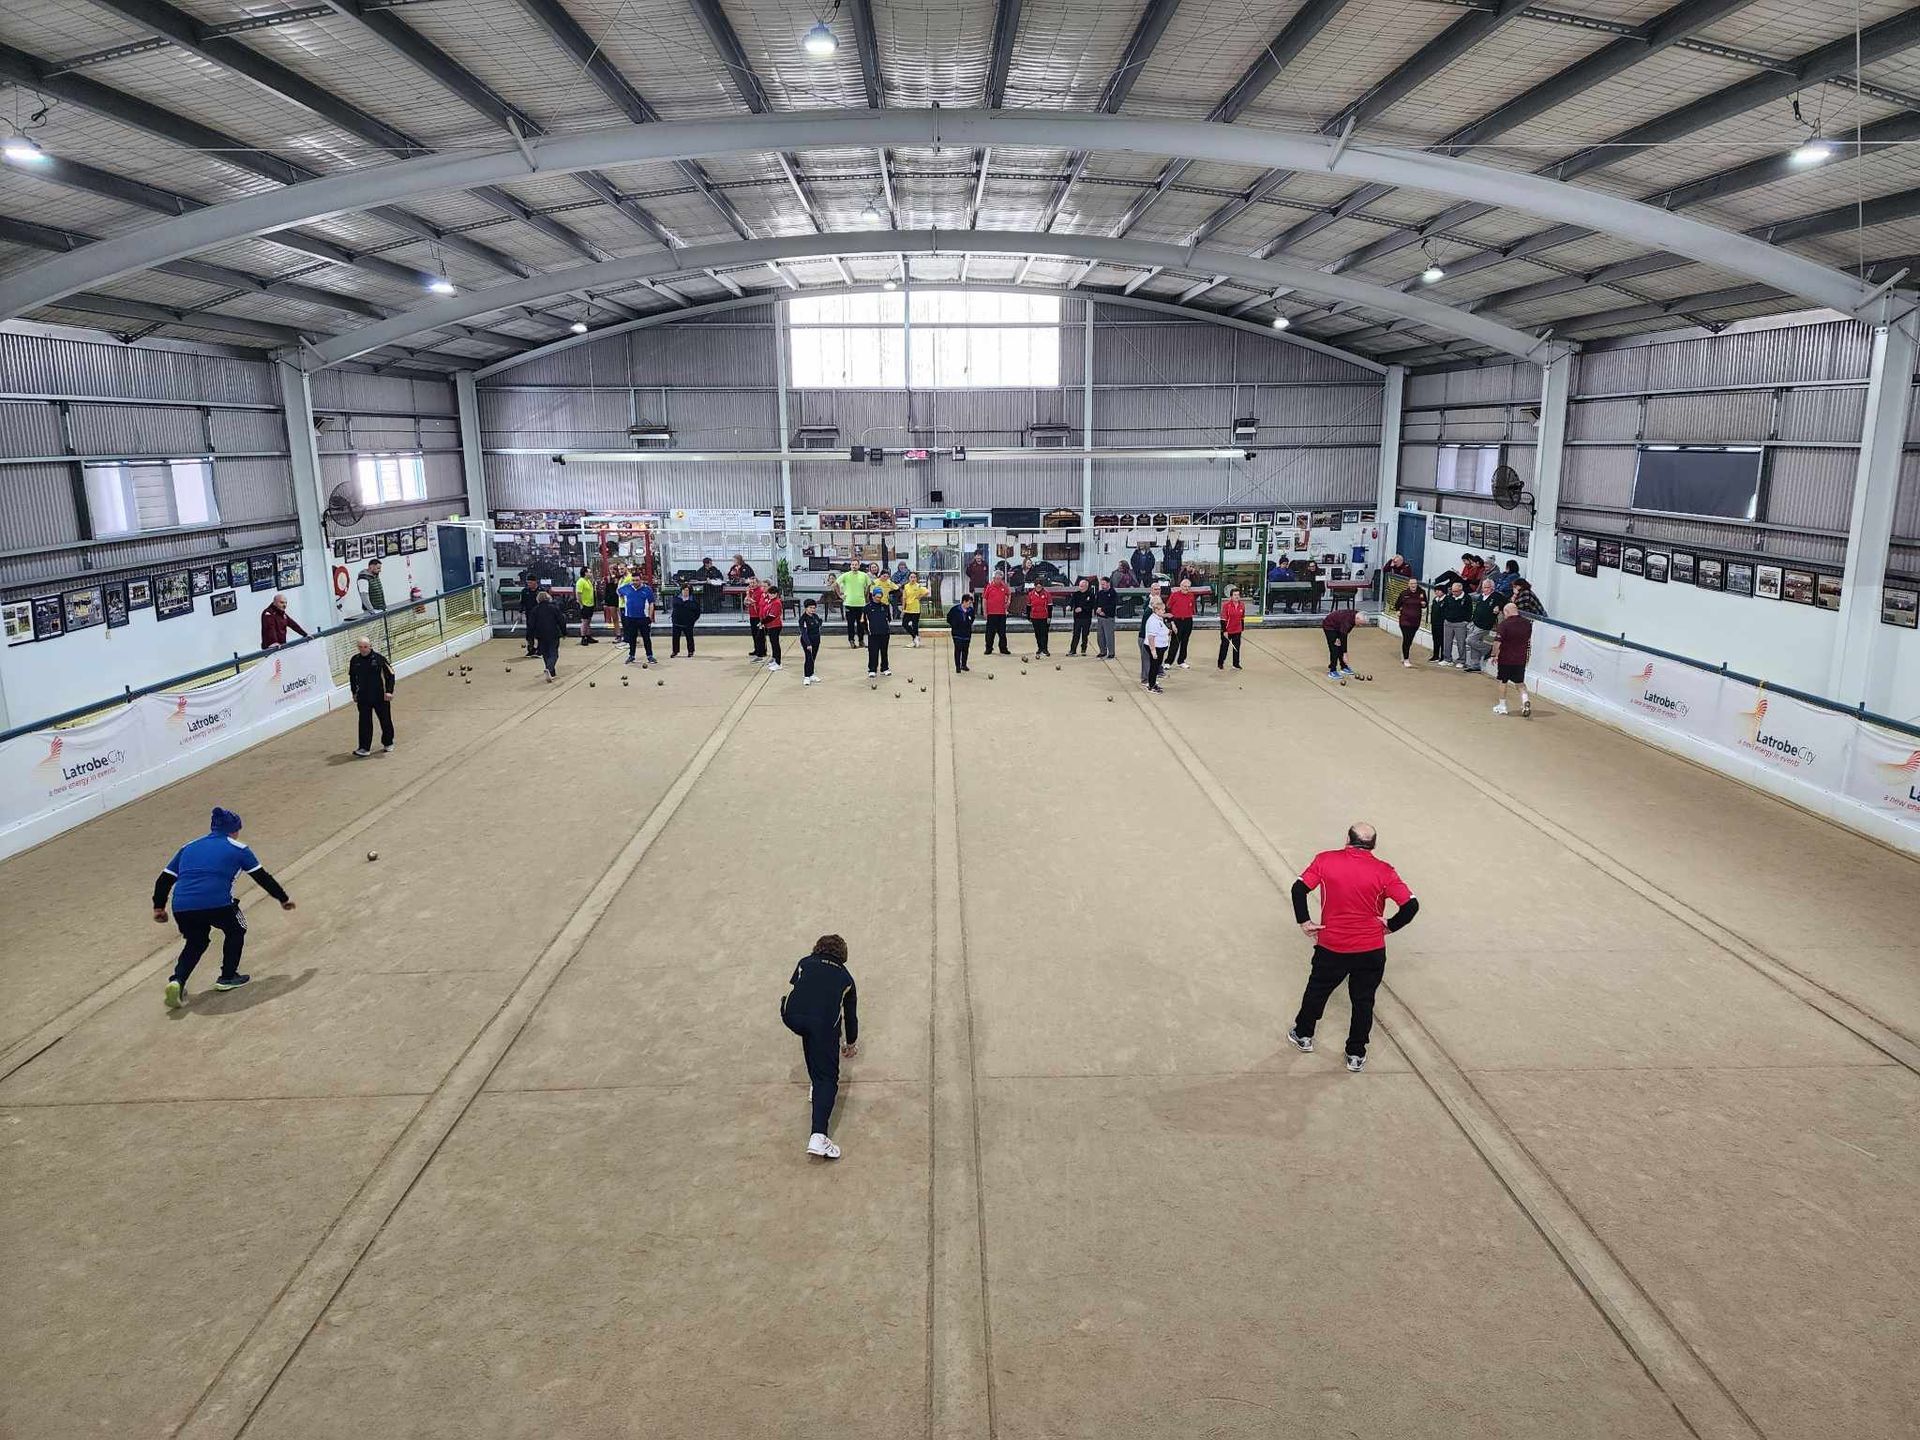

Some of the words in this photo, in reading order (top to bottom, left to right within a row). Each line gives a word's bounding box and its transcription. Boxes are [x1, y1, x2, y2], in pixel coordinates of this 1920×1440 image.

[1644, 690, 1690, 717] LatrobeCity
[187, 706, 232, 733] LatrobeCity
[1756, 730, 1817, 766] LatrobeCity
[62, 749, 126, 781] LatrobeCity
